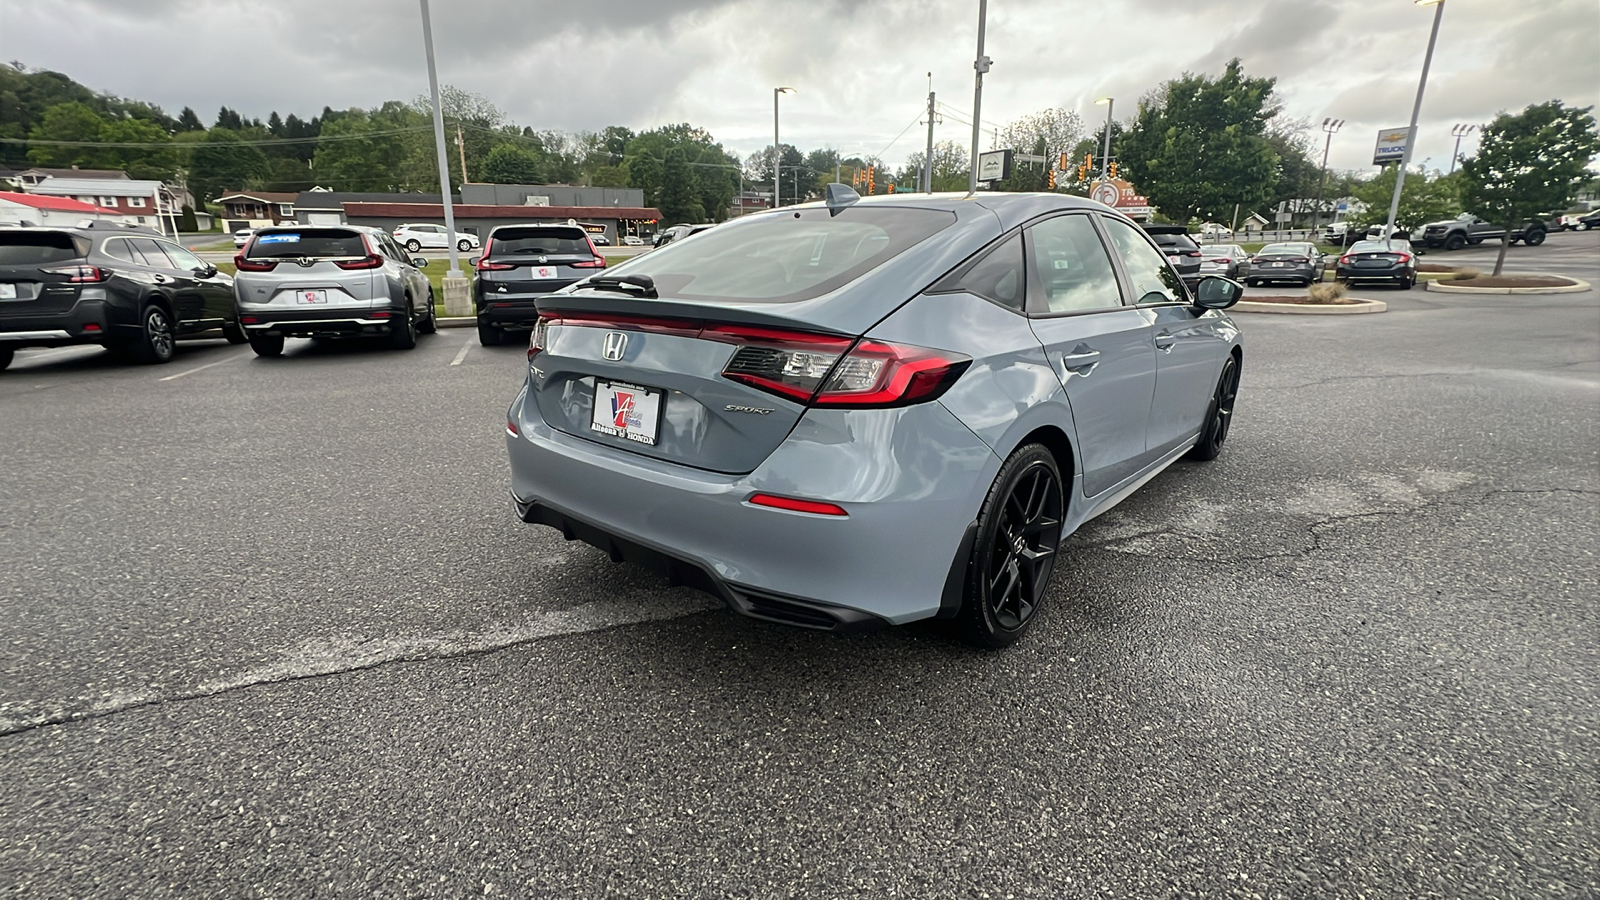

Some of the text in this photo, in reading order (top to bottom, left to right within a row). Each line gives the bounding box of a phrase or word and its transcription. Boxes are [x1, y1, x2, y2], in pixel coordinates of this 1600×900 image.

[723, 404, 775, 415] SPORT
[591, 422, 654, 445] Altoona HONDA
